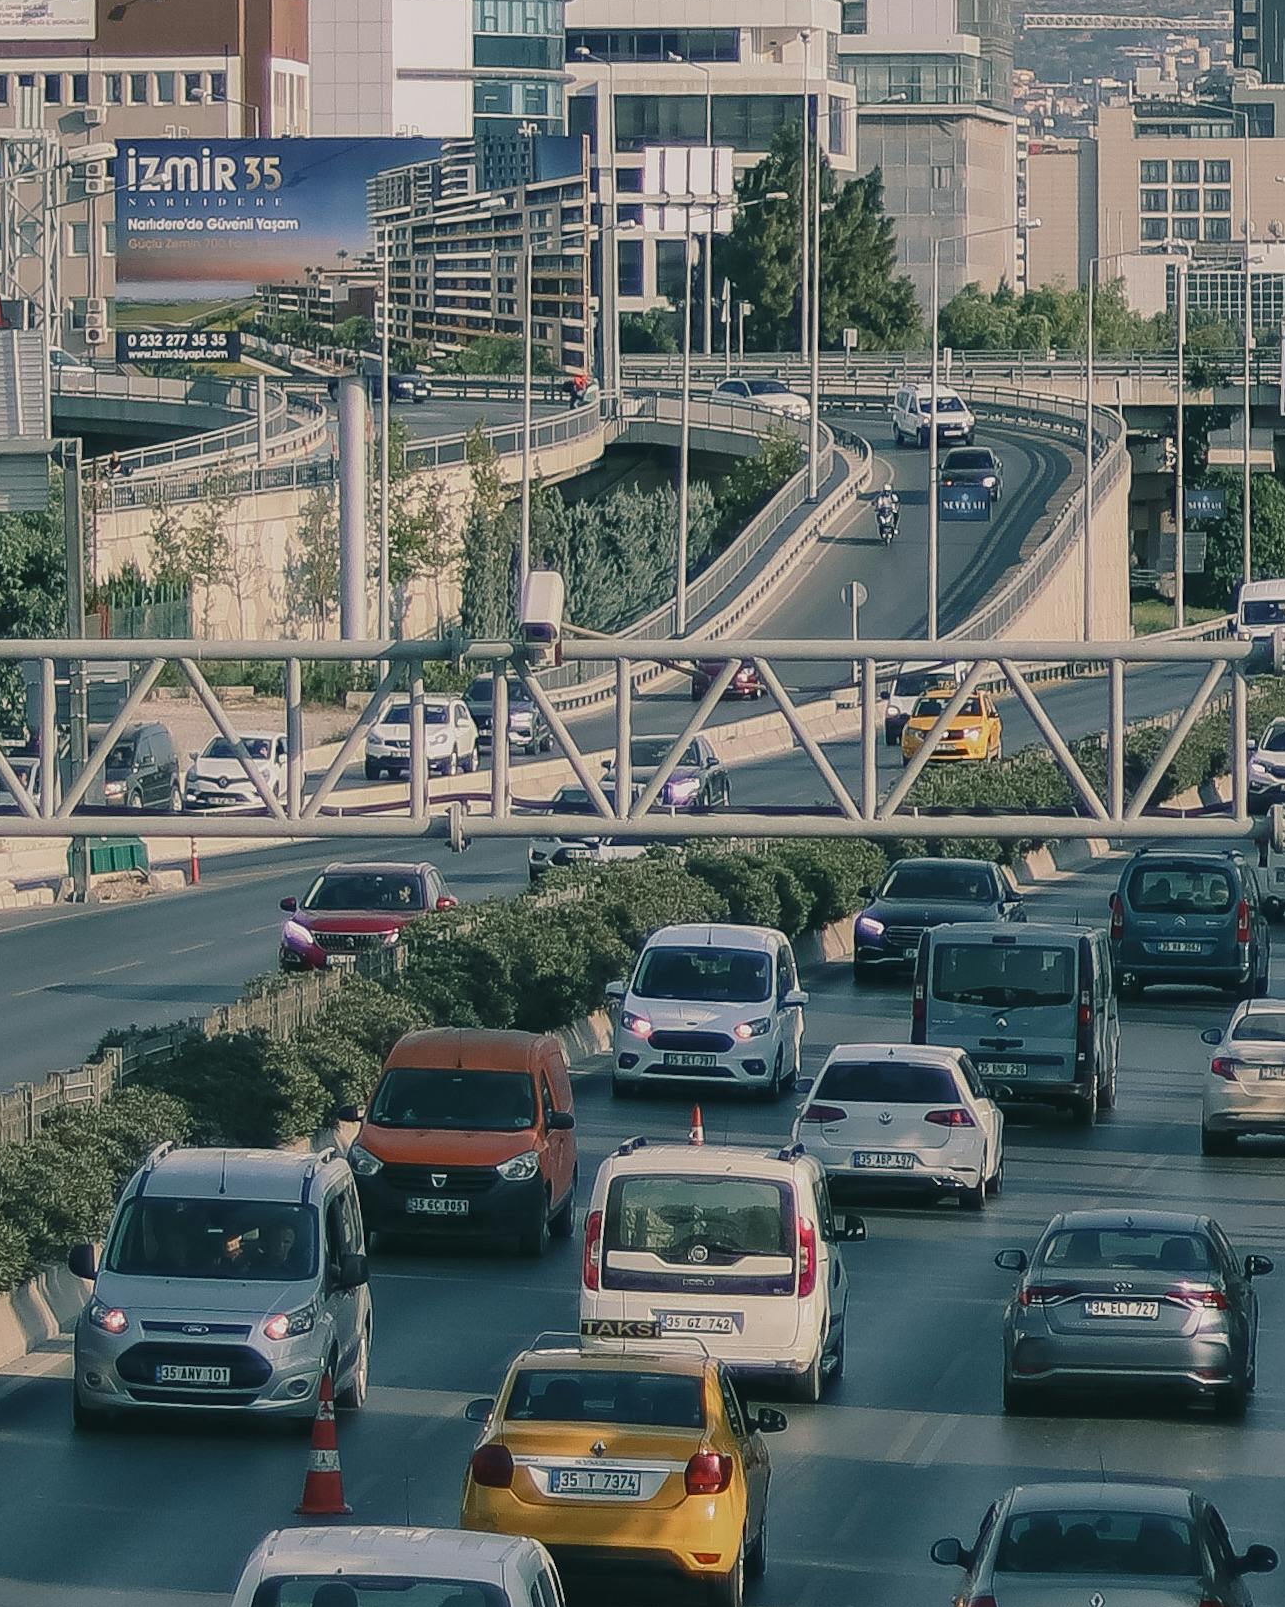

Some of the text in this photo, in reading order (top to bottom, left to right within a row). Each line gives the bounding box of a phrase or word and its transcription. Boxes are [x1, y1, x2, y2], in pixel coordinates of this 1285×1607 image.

[244, 157, 283, 191] 35
[207, 216, 254, 231] Güvenli
[256, 217, 299, 233] Yaşam
[127, 334, 227, 347] 0 232 277 35 35
[860, 1154, 871, 1164] 35
[1094, 1302, 1155, 1315] 34 ELT 727
[668, 1315, 731, 1330] 35 GZ 742
[162, 1366, 177, 1379] 35
[208, 1368, 227, 1381] 101
[561, 1472, 636, 1489] 35 T 7374
